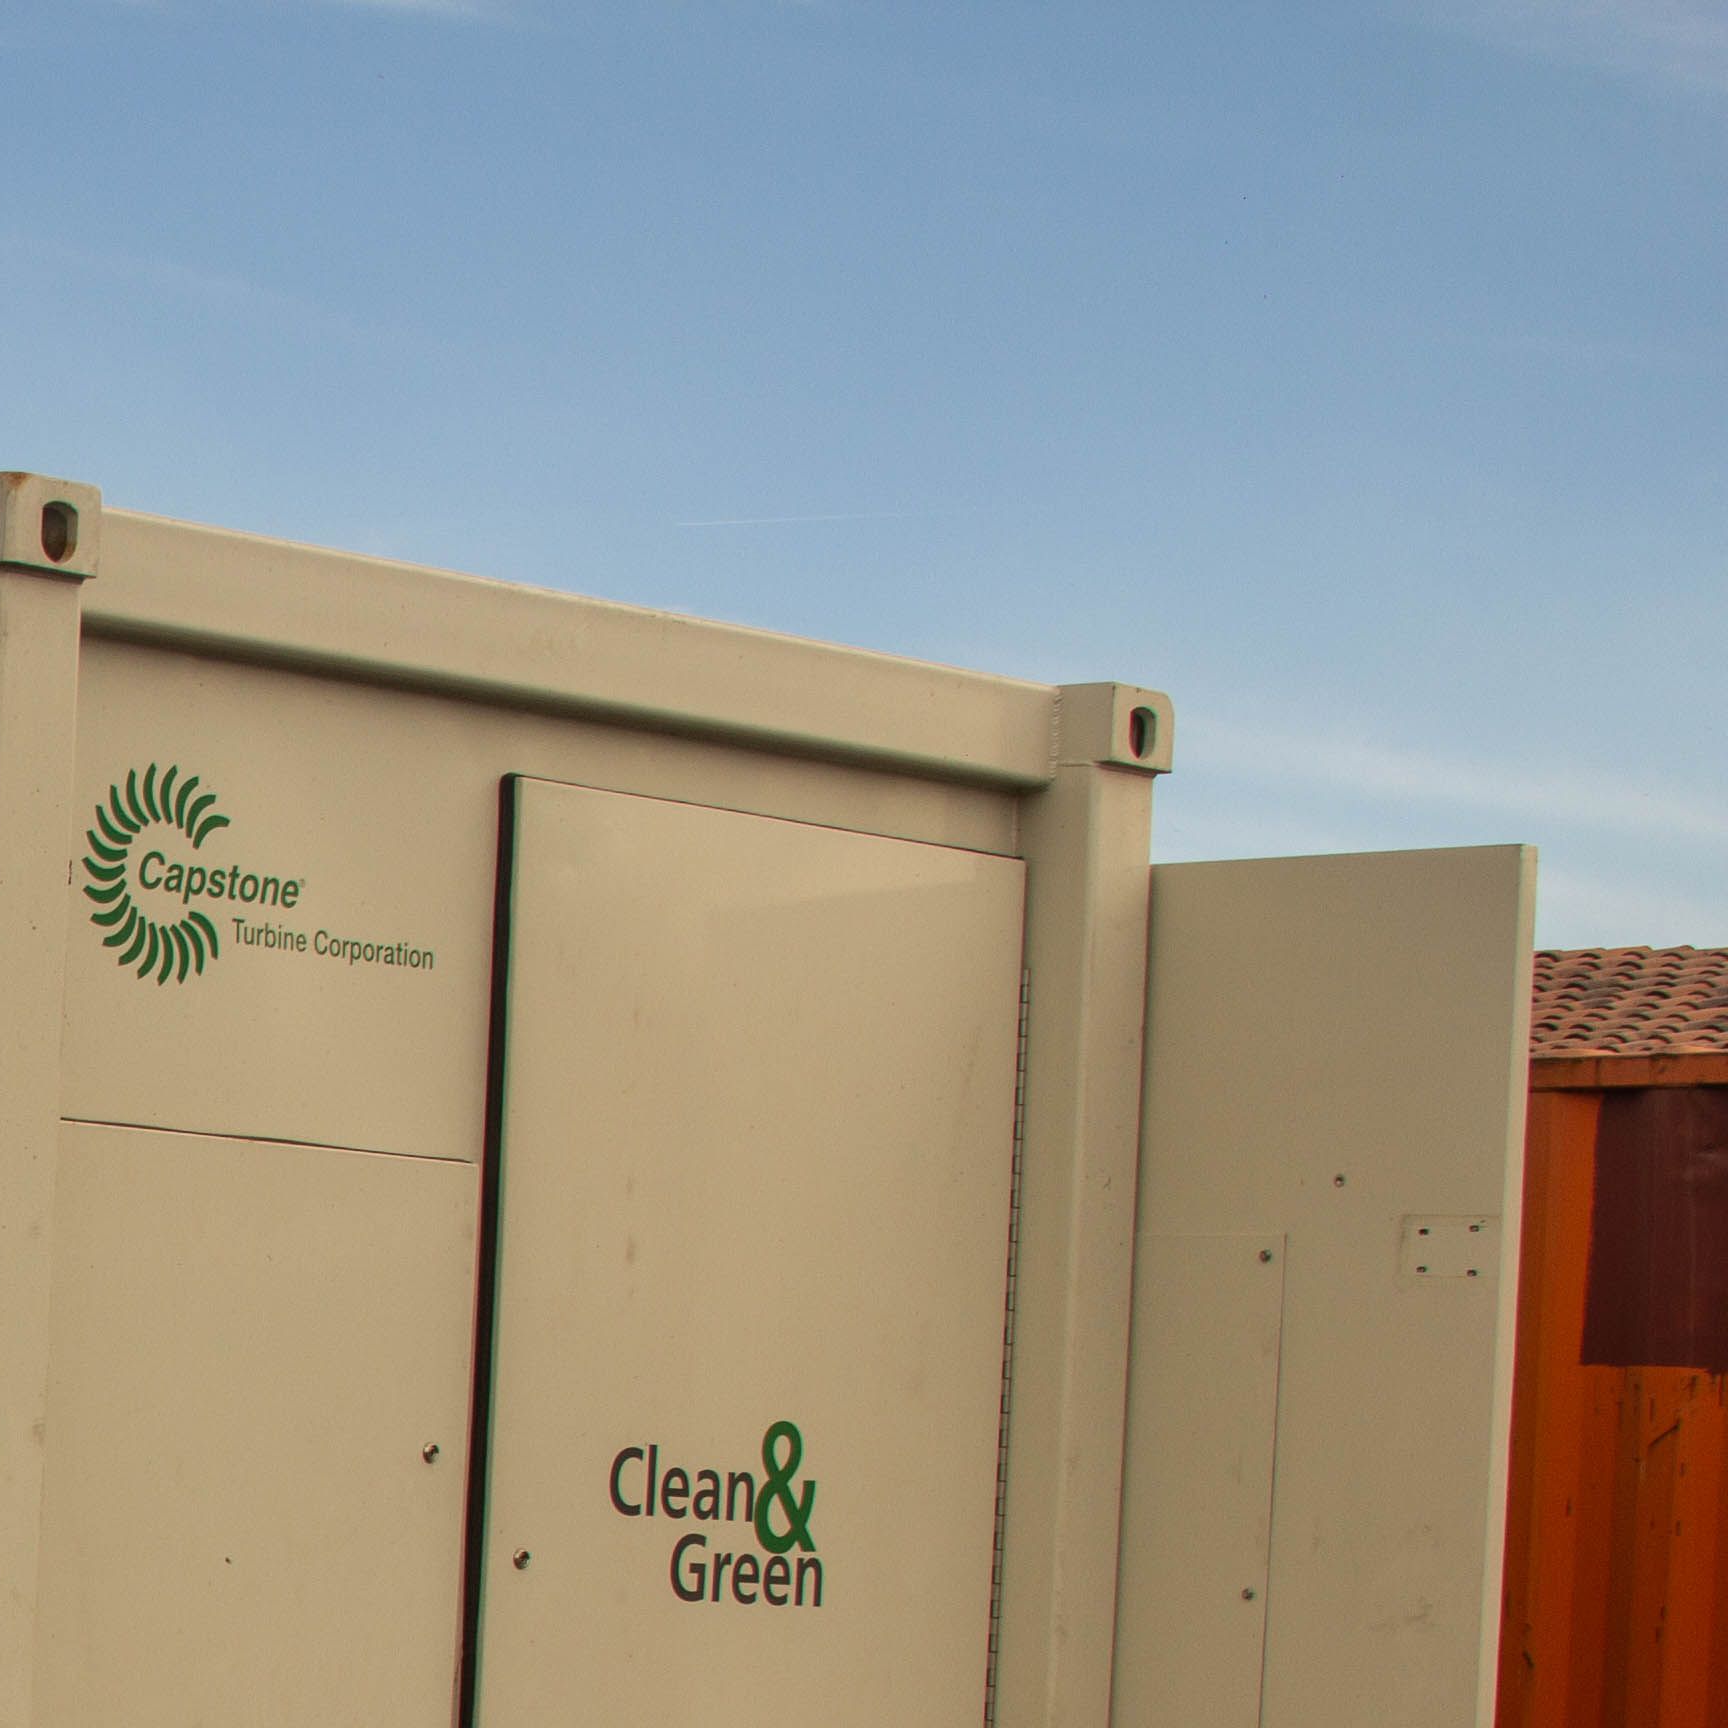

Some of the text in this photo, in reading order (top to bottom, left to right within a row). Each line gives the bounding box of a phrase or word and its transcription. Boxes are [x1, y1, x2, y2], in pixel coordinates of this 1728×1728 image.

[139, 850, 301, 908] Capstone
[231, 917, 435, 971] Turbine Corporation
[669, 1533, 824, 1608] Green
